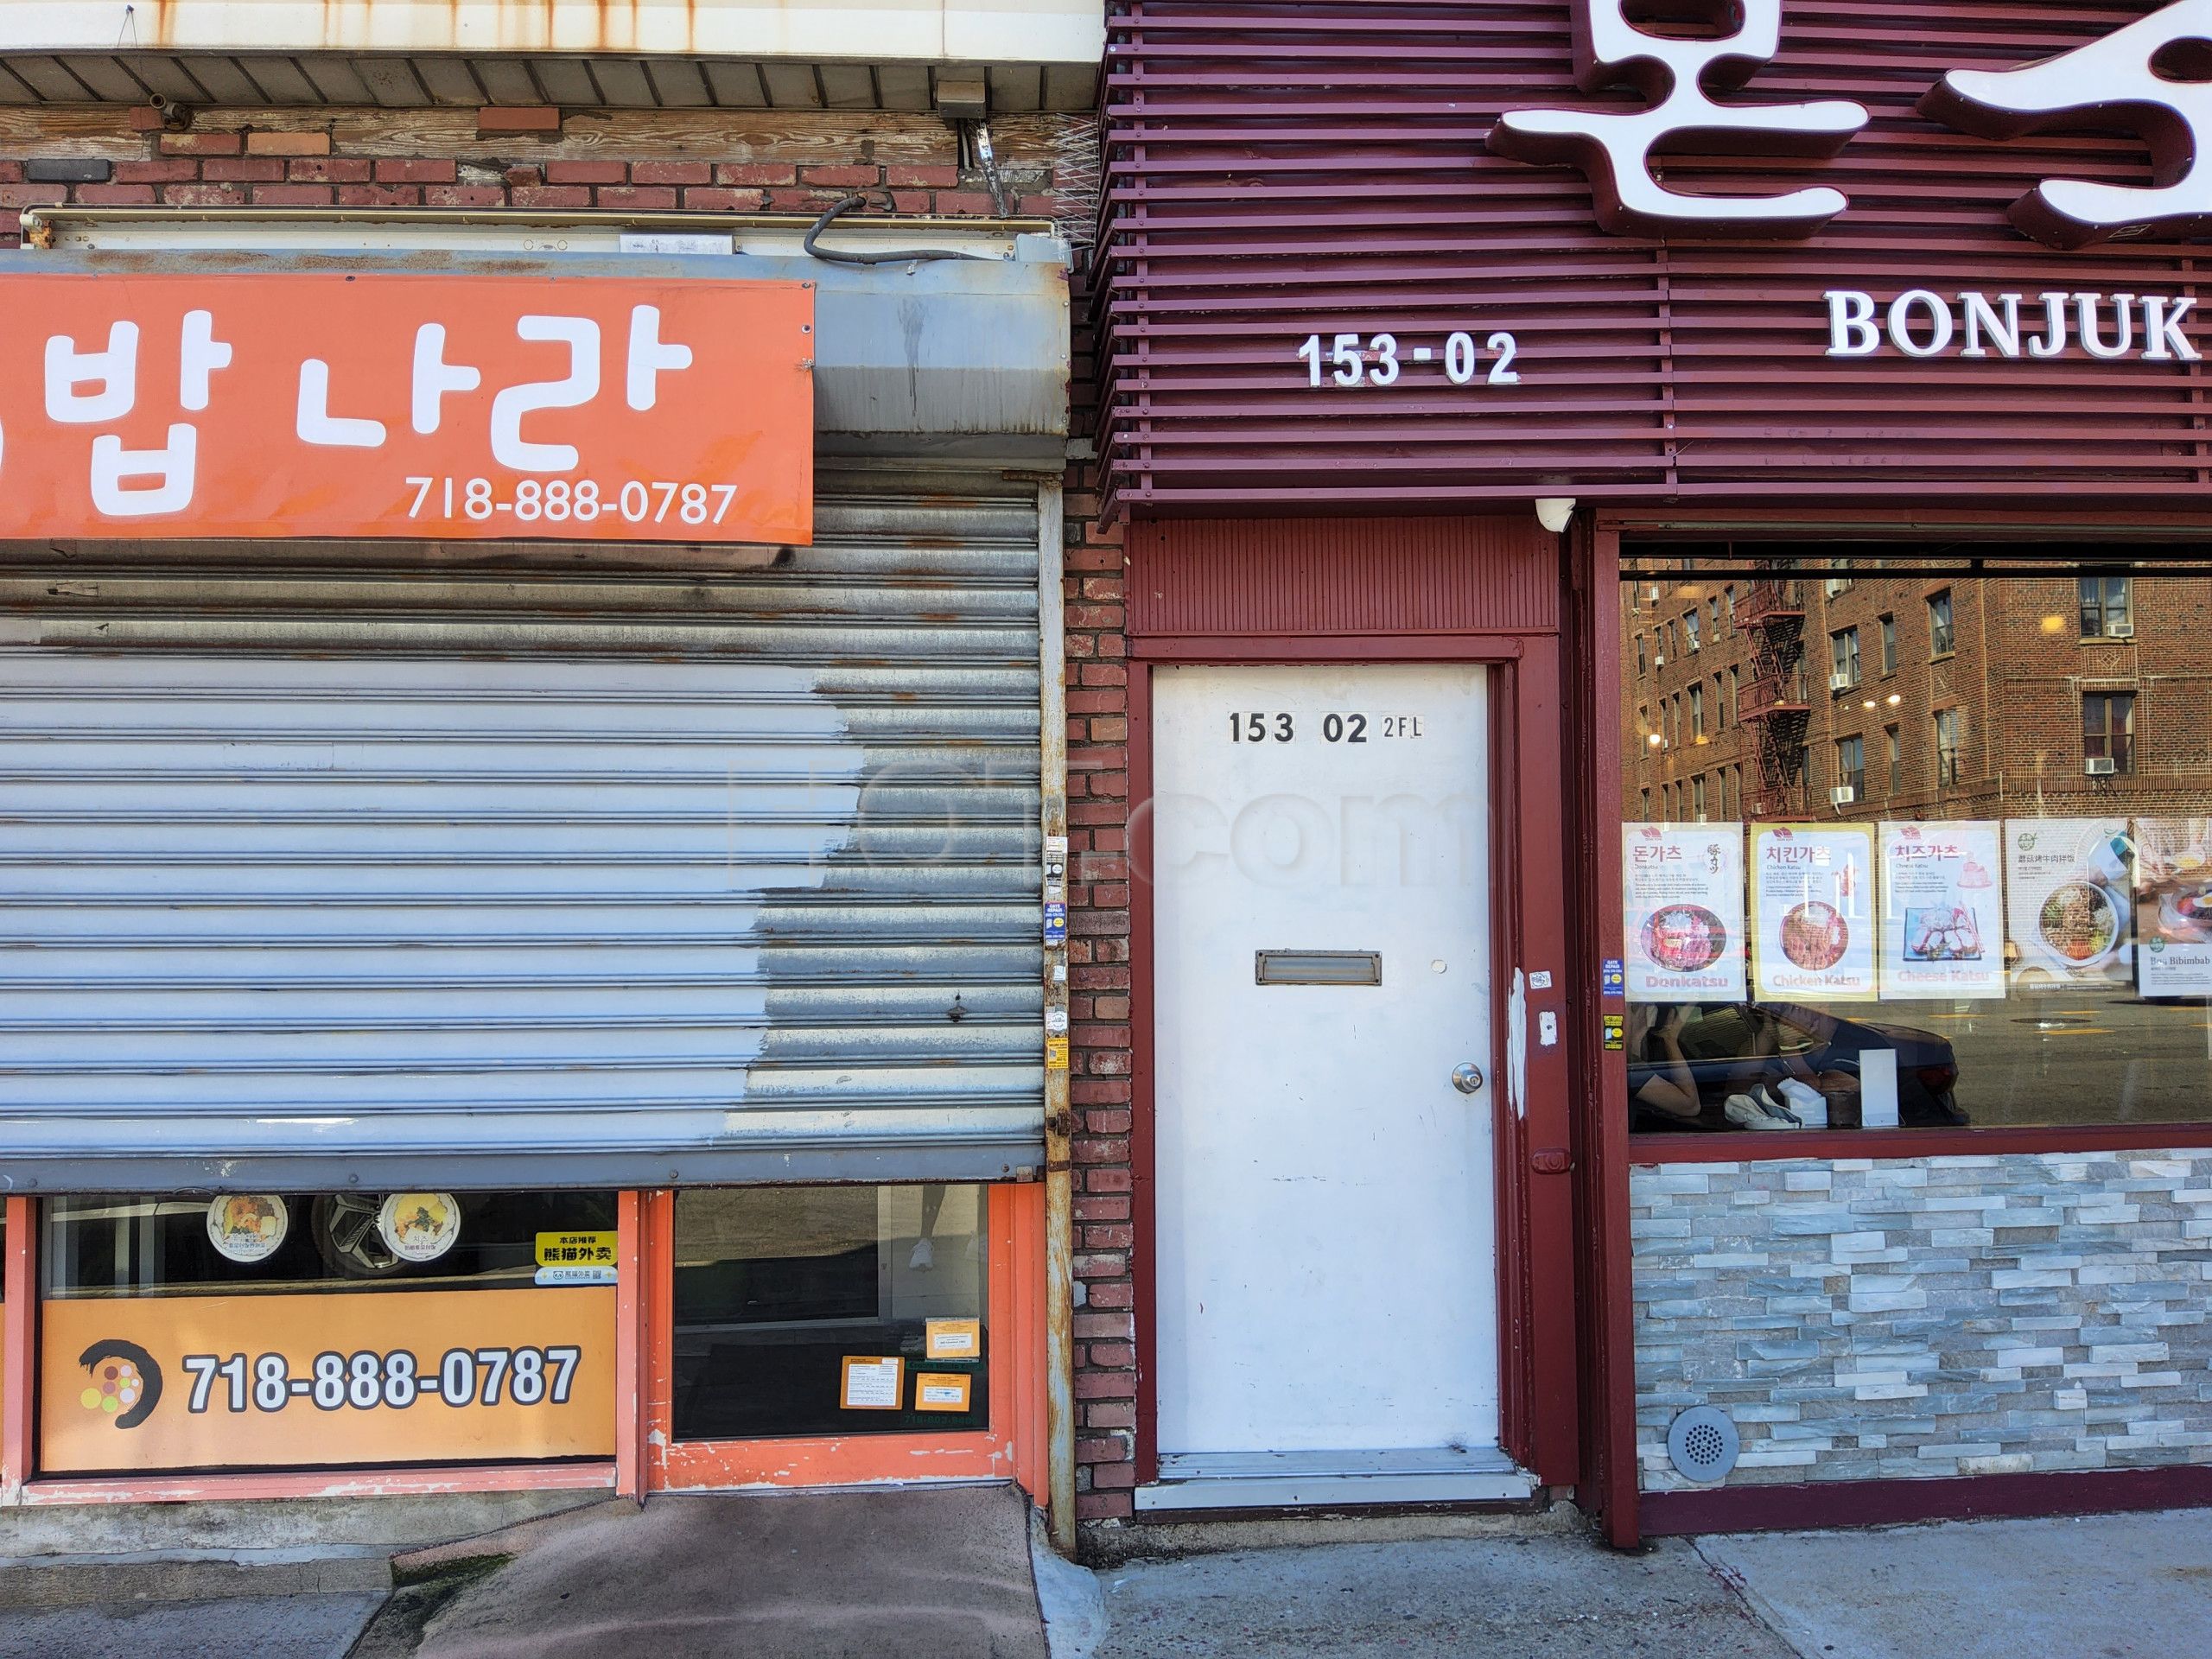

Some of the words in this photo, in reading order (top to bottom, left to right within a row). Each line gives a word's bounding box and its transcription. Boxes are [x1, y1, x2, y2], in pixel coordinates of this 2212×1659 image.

[1824, 290, 2202, 359] BONJUK
[1296, 332, 1520, 387] 153-02
[405, 477, 739, 526] 718-888-0787
[1230, 711, 1294, 743] 153
[1322, 713, 1368, 743] 02
[1383, 715, 1422, 738] 2FL
[1632, 845, 1682, 862] 돈가츠
[1766, 845, 1831, 863] 치킨가츠
[1894, 844, 1960, 861] 치즈가츠
[2170, 955, 2210, 965] Bibimbab
[1645, 975, 1728, 988] Donkatsu
[1773, 974, 1821, 987] Chicken
[1824, 975, 1860, 987] Katsu
[1897, 969, 1946, 982] Cheese
[1951, 969, 1988, 982] Katsu
[559, 1236, 596, 1244] 本店推荐
[543, 1247, 612, 1261] 熊猫外卖
[182, 1345, 582, 1413] 718-888-0787
